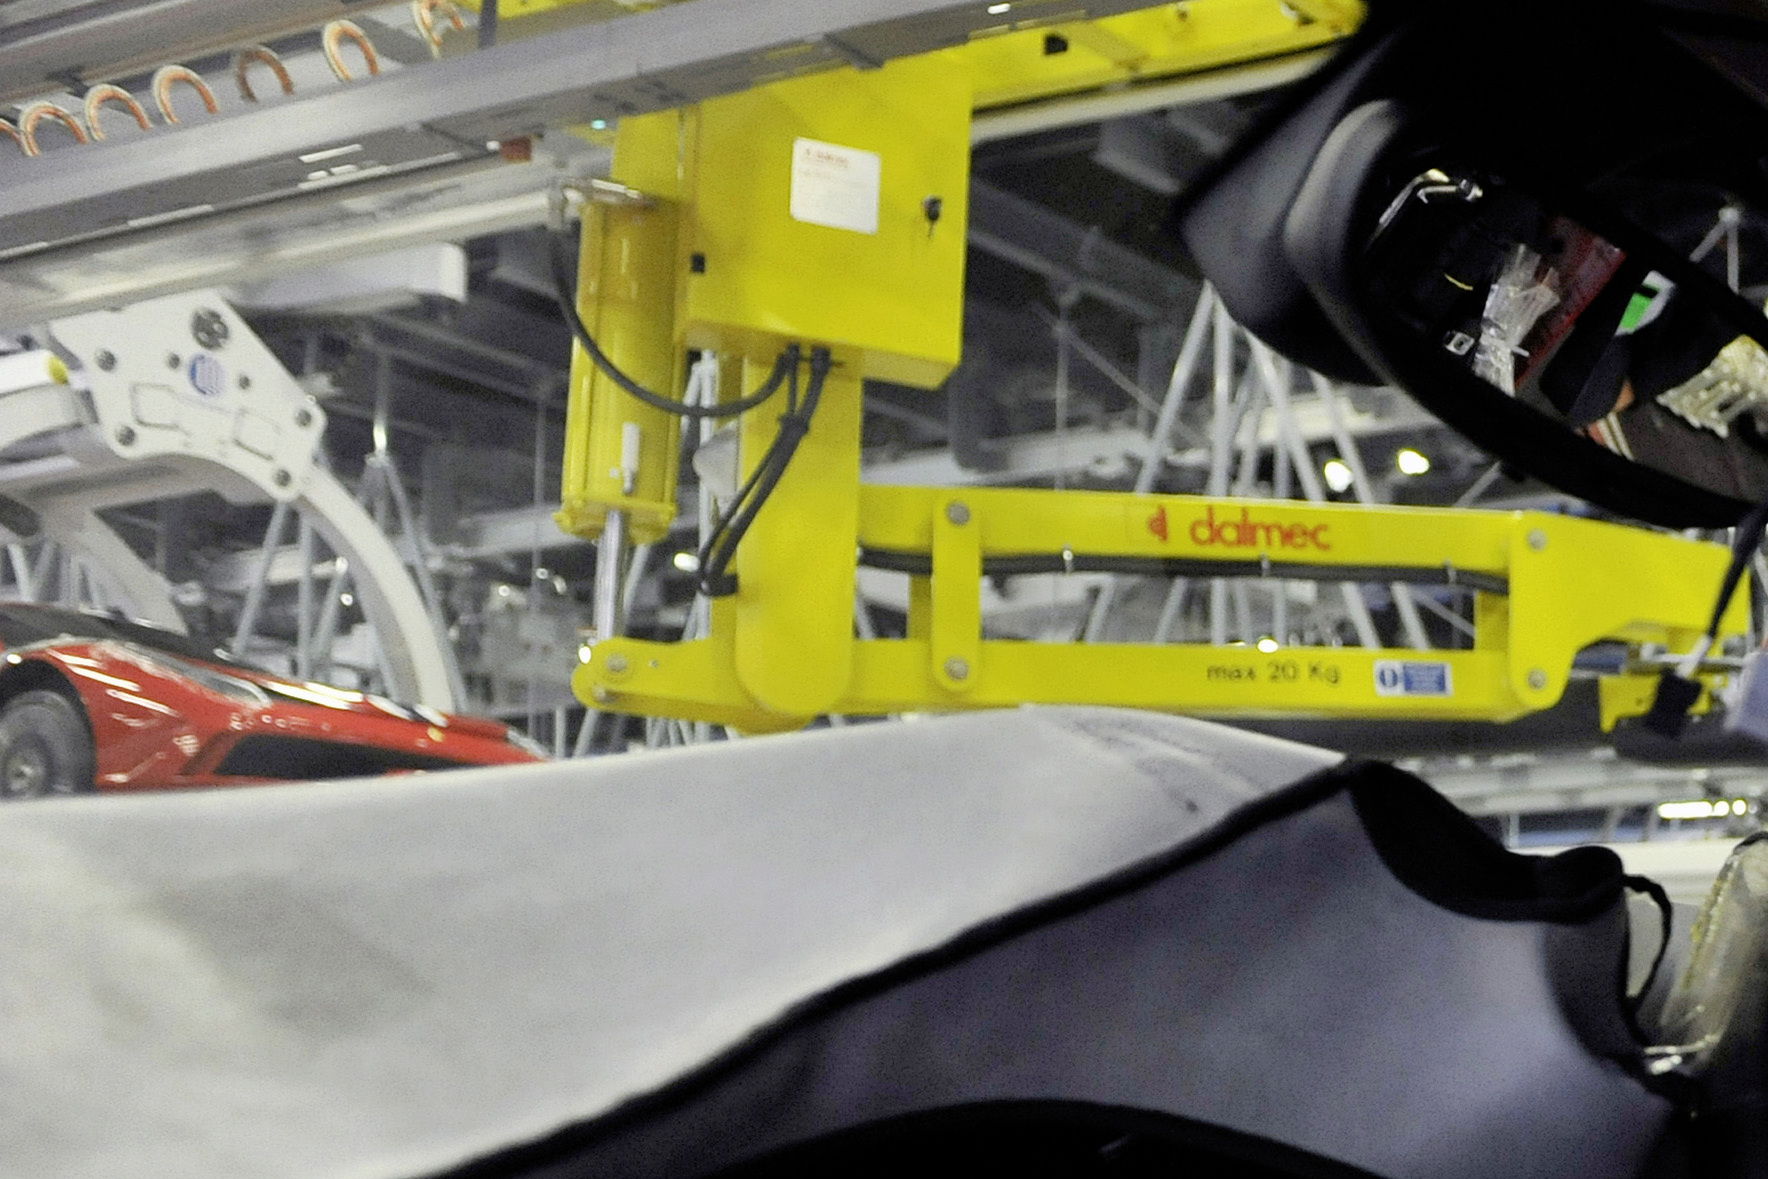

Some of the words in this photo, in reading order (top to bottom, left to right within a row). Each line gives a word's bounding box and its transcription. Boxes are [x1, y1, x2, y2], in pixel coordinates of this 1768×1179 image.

[1190, 504, 1331, 551] dalmec
[1206, 663, 1256, 682] max
[1267, 659, 1298, 682] 20
[1308, 660, 1341, 686] Kg
